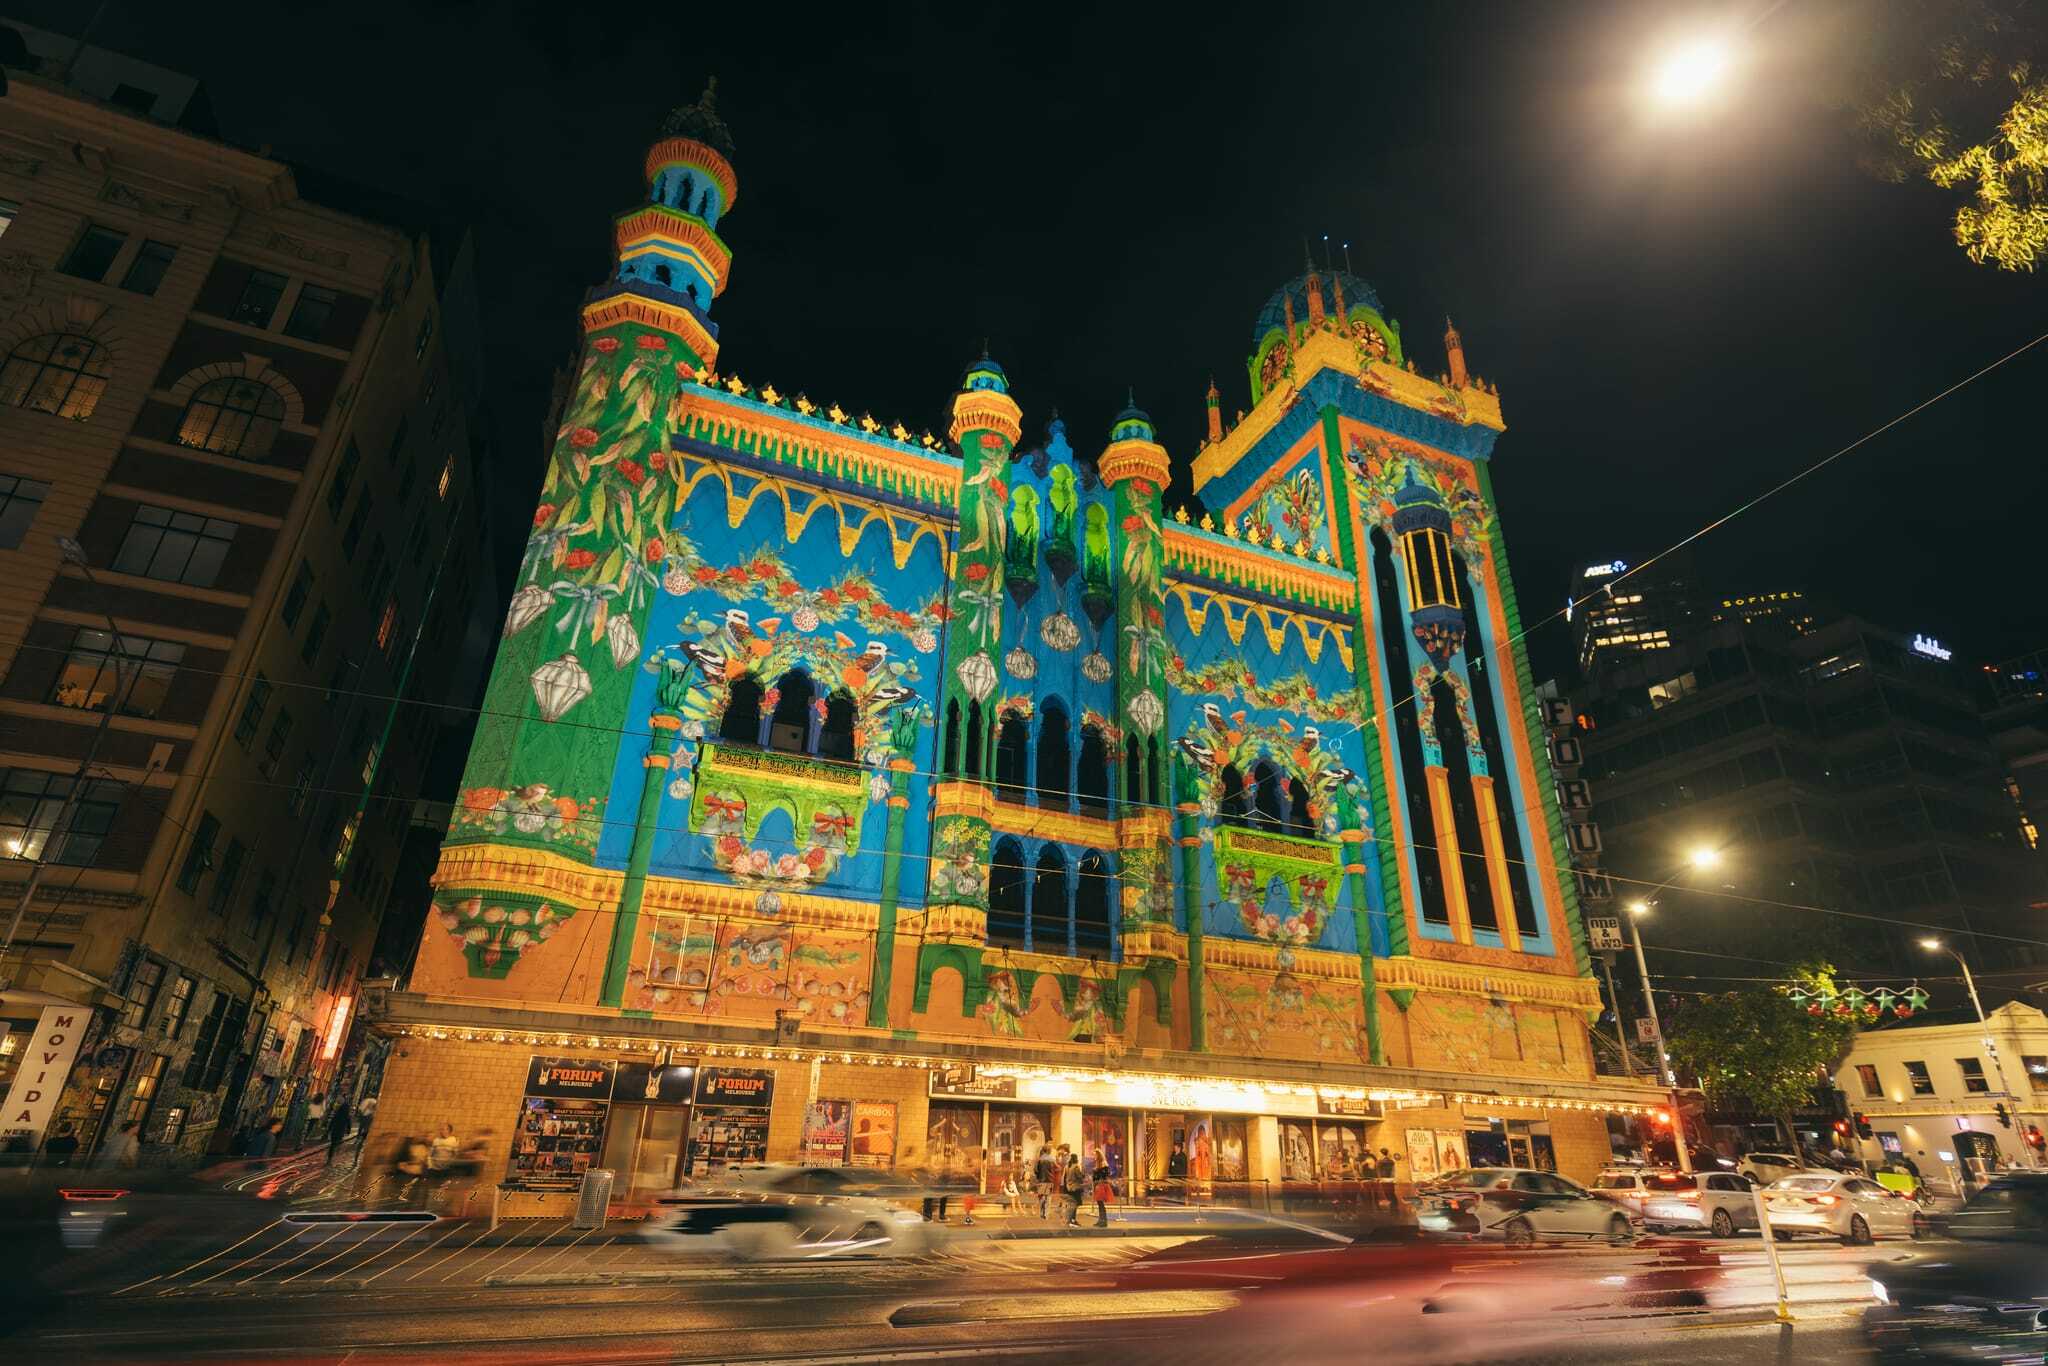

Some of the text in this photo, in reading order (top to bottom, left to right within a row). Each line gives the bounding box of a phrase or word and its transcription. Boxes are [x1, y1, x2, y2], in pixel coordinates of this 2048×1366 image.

[1720, 591, 1803, 608] SOFITEL
[1546, 697, 1613, 899] FORUM
[15, 1015, 74, 1122] MOVIDA
[551, 1068, 605, 1082] FORUM
[717, 1077, 766, 1090] FORUM
[856, 1106, 896, 1117] CARIBOU
